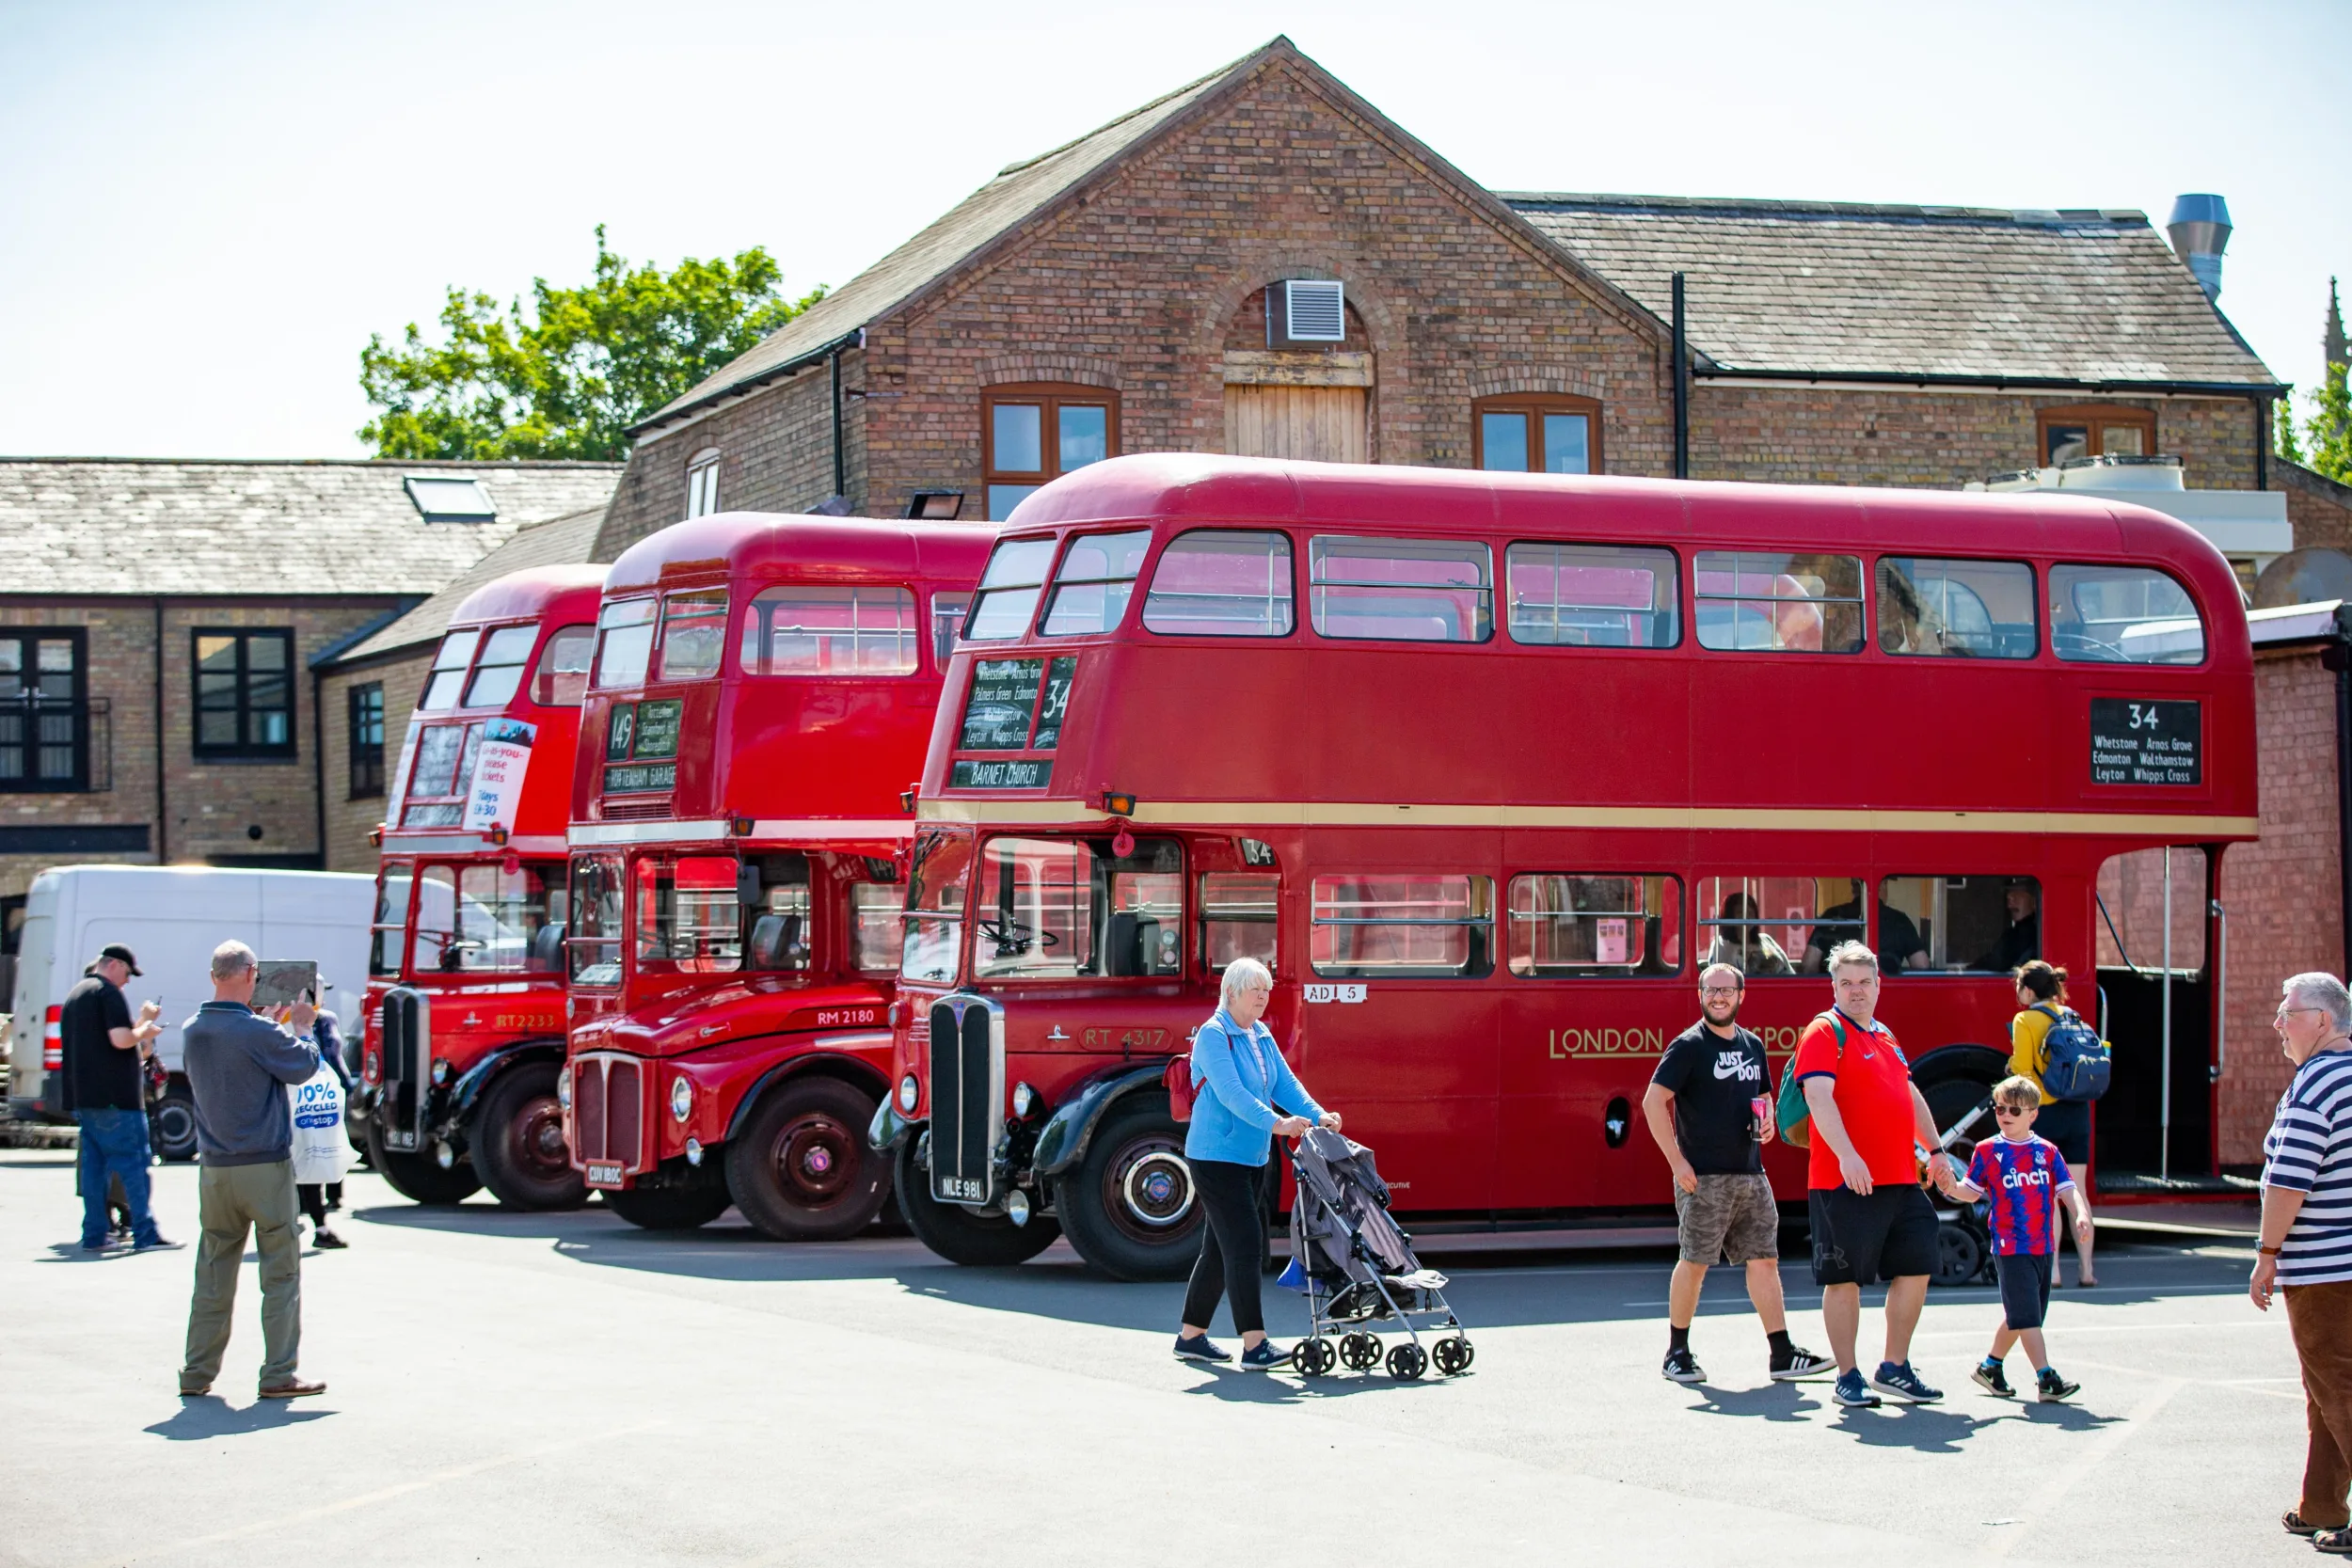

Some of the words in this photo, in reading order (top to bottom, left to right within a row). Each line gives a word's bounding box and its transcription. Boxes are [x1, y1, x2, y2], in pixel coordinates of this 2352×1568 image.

[1011, 666, 1029, 679] Arnos
[1030, 663, 1042, 679] Grov
[974, 686, 994, 702] Palmers
[995, 685, 1012, 700] Green
[1014, 684, 1038, 700] Edmonto
[1042, 679, 1073, 719] 34
[2128, 704, 2159, 730] 34
[611, 713, 633, 750] 149
[966, 727, 987, 746] Leyton
[992, 726, 1012, 746] Whipps
[1012, 726, 1029, 742] Cross
[2094, 735, 2138, 750] Whetstone
[2146, 736, 2169, 751] Arnos
[2171, 737, 2193, 752] Grove
[2092, 751, 2131, 765] Edmonton
[2139, 752, 2194, 767] Walthamstow
[650, 765, 675, 785] GARAGE
[971, 764, 1006, 784] BARNET
[1006, 764, 1039, 784] CHURCH
[2096, 767, 2125, 784] Leyton
[2134, 767, 2165, 784] Whipps
[2168, 768, 2190, 782] Cross
[1246, 838, 1271, 863] 34
[1310, 986, 1329, 1000] AD
[1347, 986, 1357, 999] 5
[818, 1011, 839, 1025] RM
[842, 1009, 874, 1023] 2180
[1086, 1028, 1111, 1046] RT
[1120, 1029, 1166, 1046] 4317
[1549, 1027, 1663, 1059] LONDON
[1718, 1051, 1743, 1067] JUST
[943, 1178, 962, 1196] NLE
[963, 1180, 980, 1198] 981
[2002, 1167, 2050, 1189] cinch
